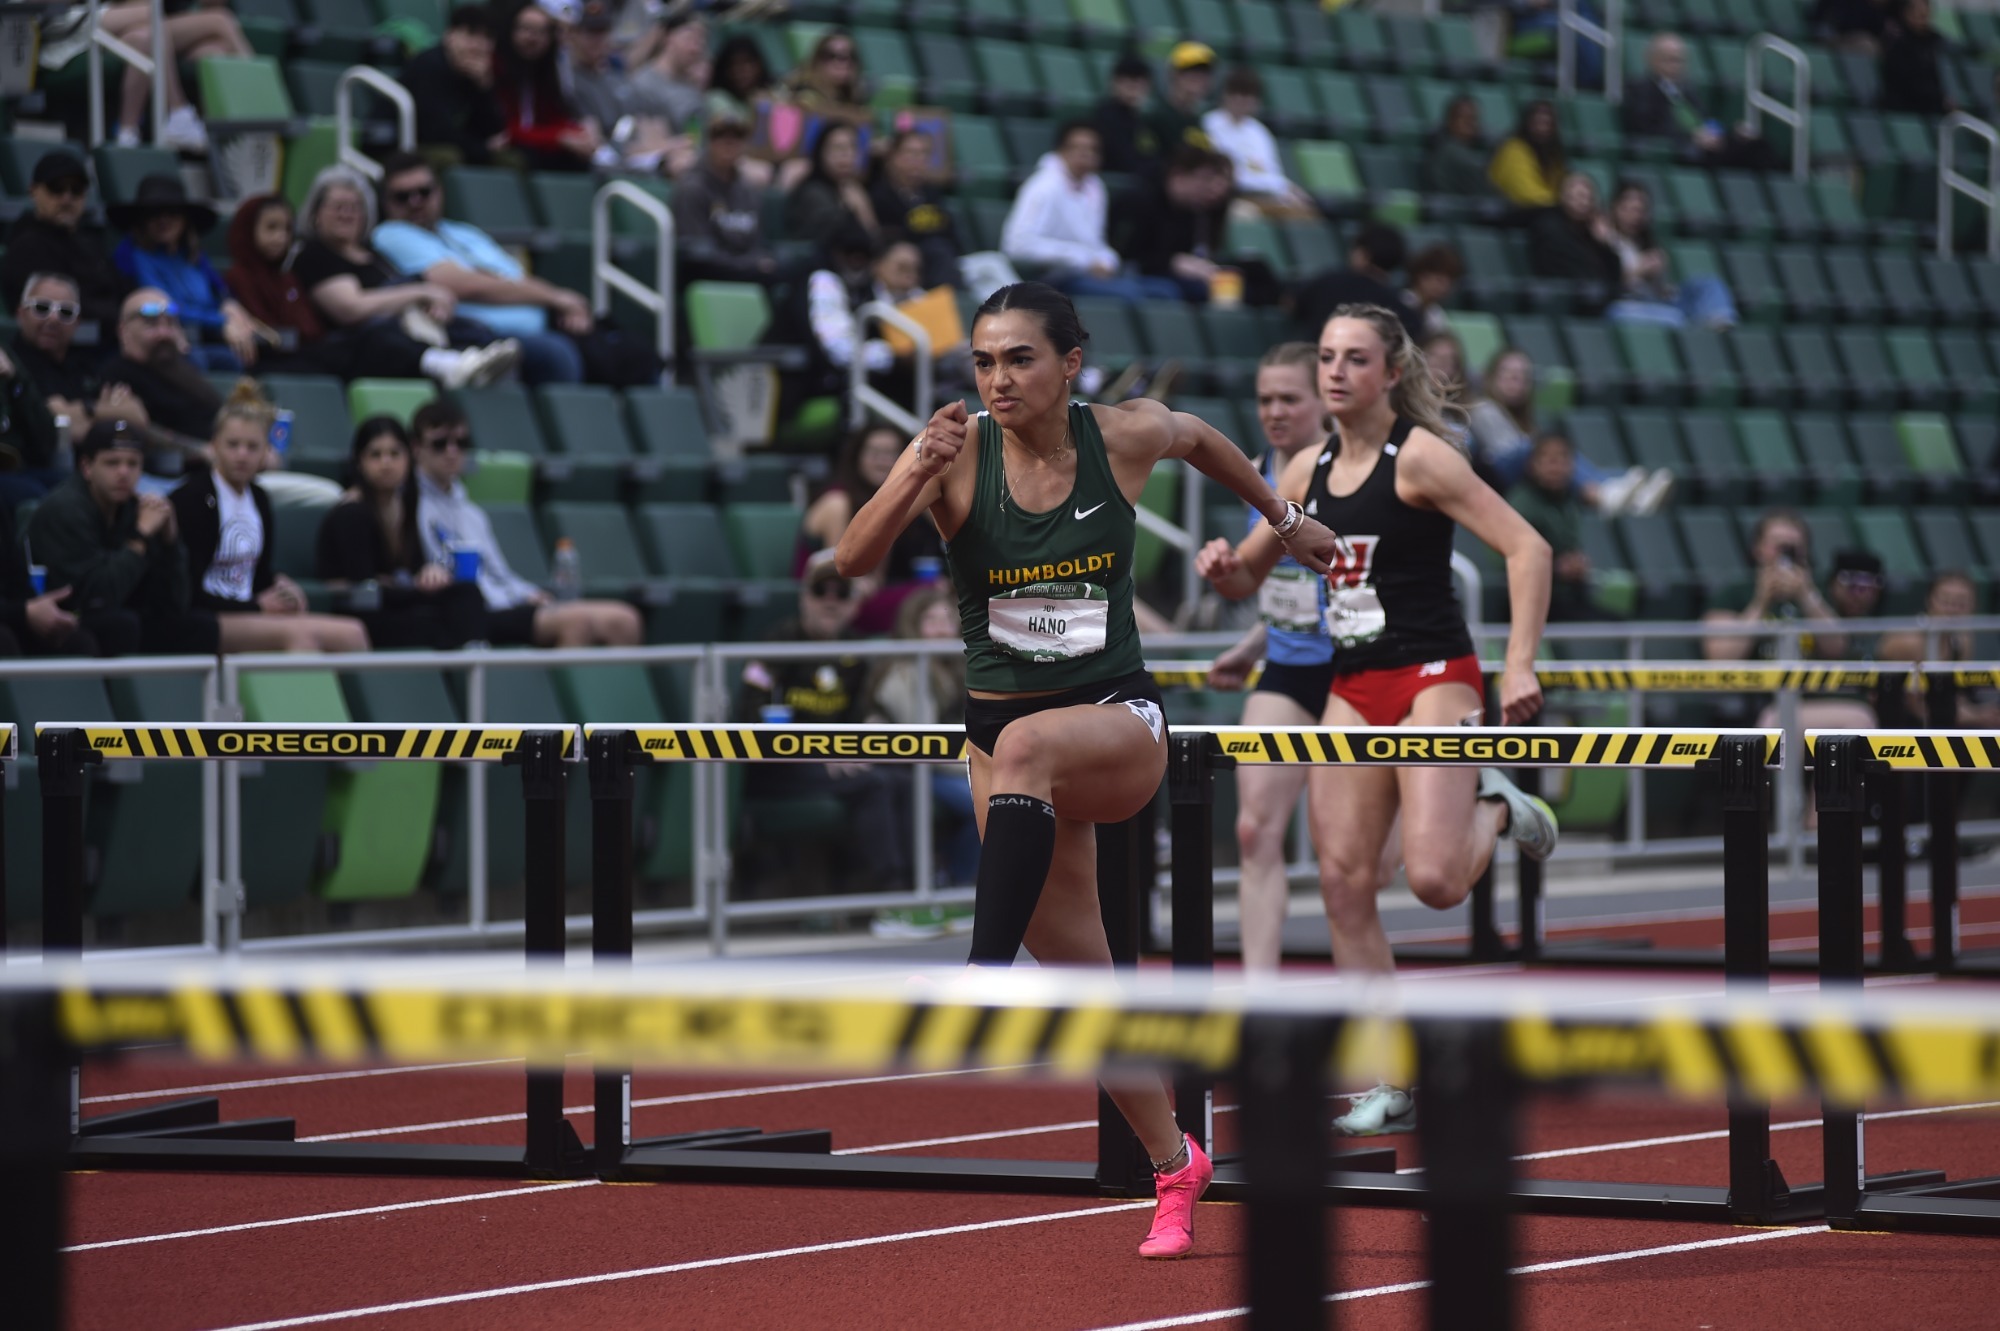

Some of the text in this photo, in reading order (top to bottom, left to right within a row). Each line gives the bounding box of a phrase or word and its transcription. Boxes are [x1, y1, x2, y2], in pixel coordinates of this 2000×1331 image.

[988, 552, 1116, 585] HUMBOLDT
[1024, 584, 1078, 594] OREGON PREVIEW
[1042, 604, 1056, 613] JOY
[1028, 616, 1067, 635] HANO
[93, 733, 514, 753] GILL OREGON GILL
[644, 734, 949, 755] GILL OREGON
[1226, 737, 1708, 759] GILL OREGON GILL
[1878, 745, 1916, 758] GILL
